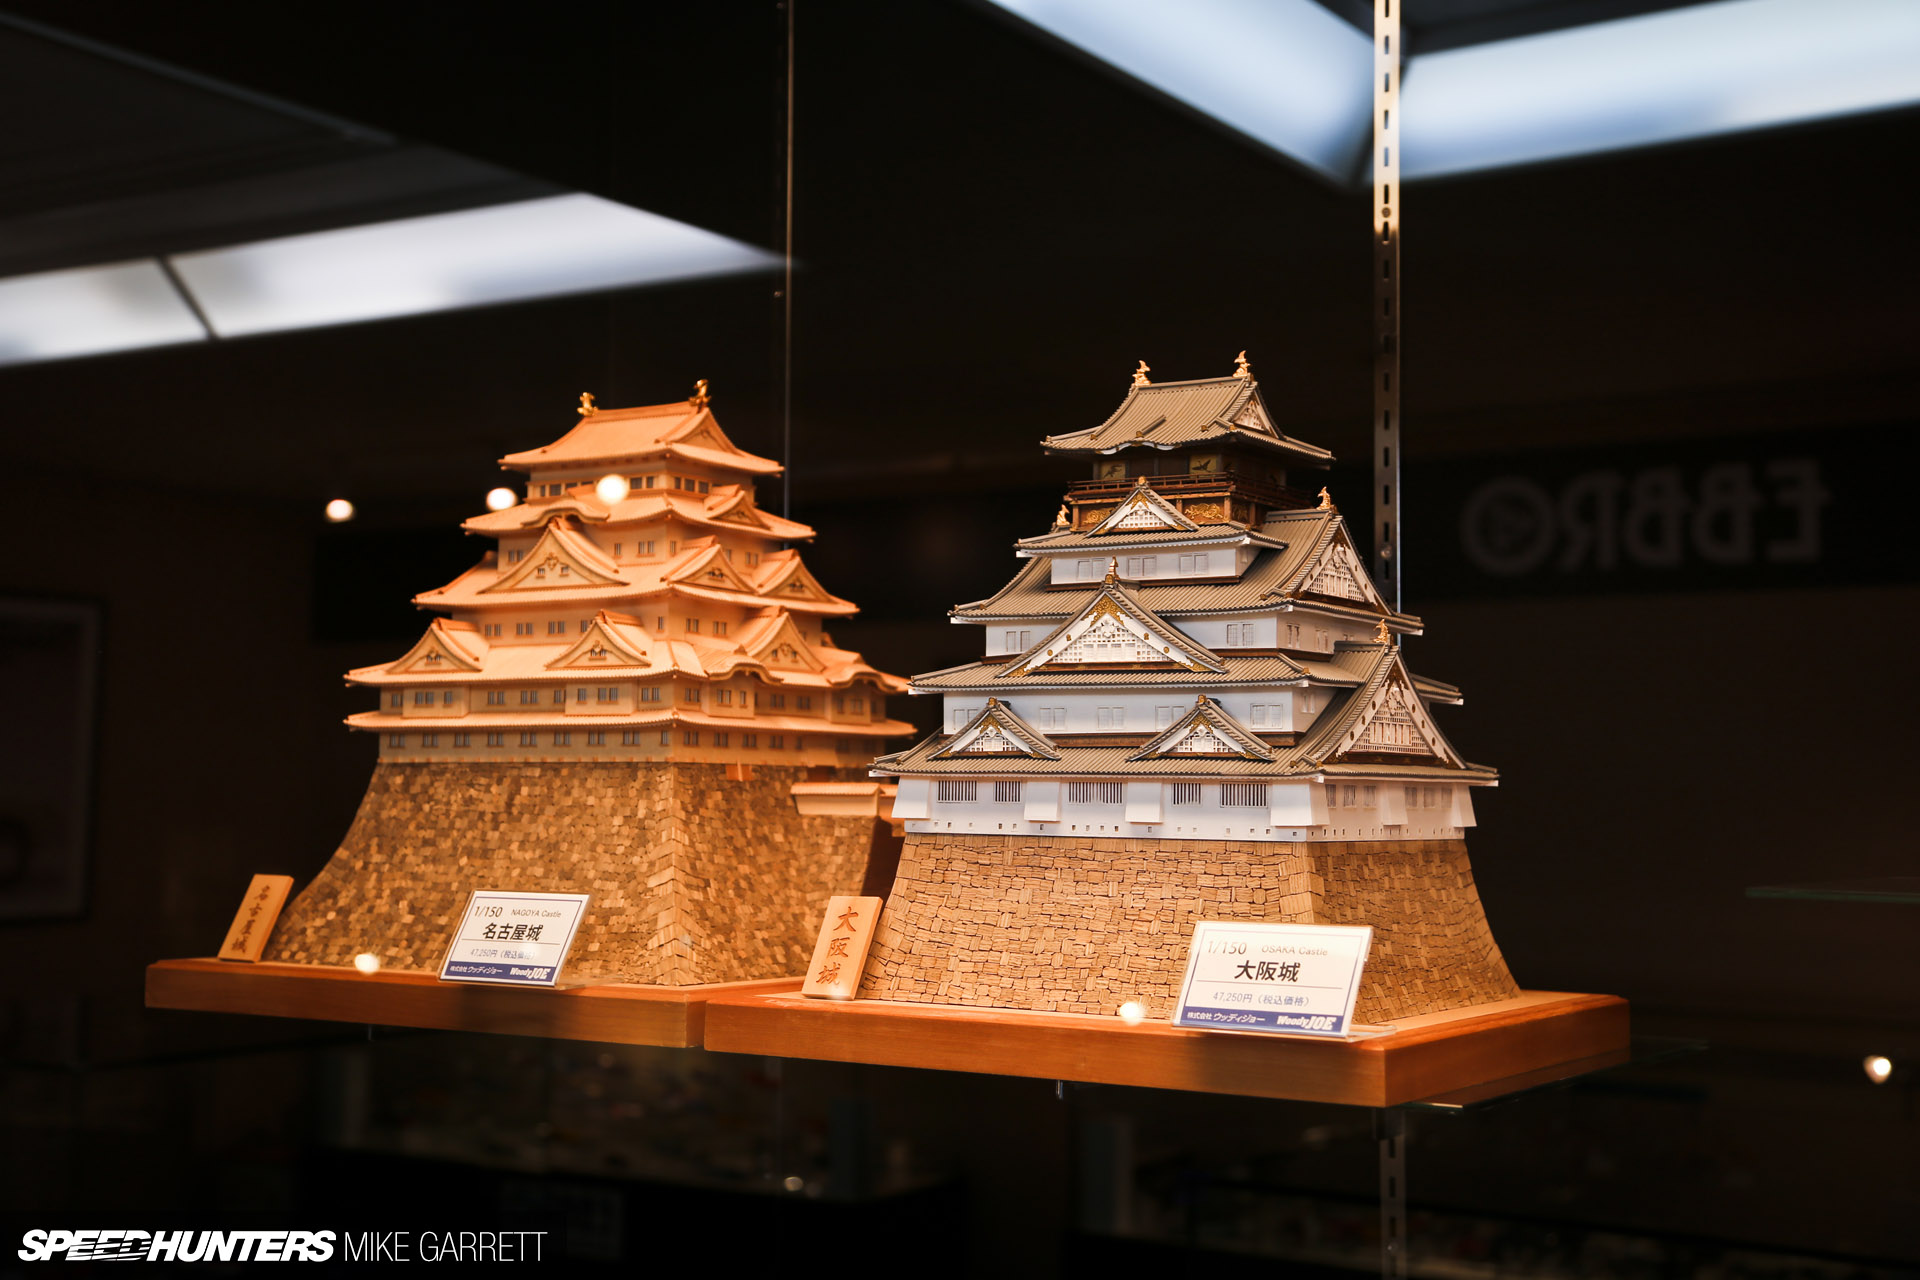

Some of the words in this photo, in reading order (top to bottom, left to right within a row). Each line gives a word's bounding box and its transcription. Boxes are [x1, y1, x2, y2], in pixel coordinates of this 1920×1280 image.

[473, 906, 503, 918] 1/150
[510, 909, 540, 917] NAGOYA
[541, 910, 562, 918] Castle
[482, 922, 544, 942] 名古屋城
[816, 906, 859, 985] 大阪城
[1207, 940, 1247, 955] 1/150
[1261, 944, 1296, 955] OSAKA
[1298, 947, 1328, 957] Castle
[1234, 960, 1301, 982] 大阪城
